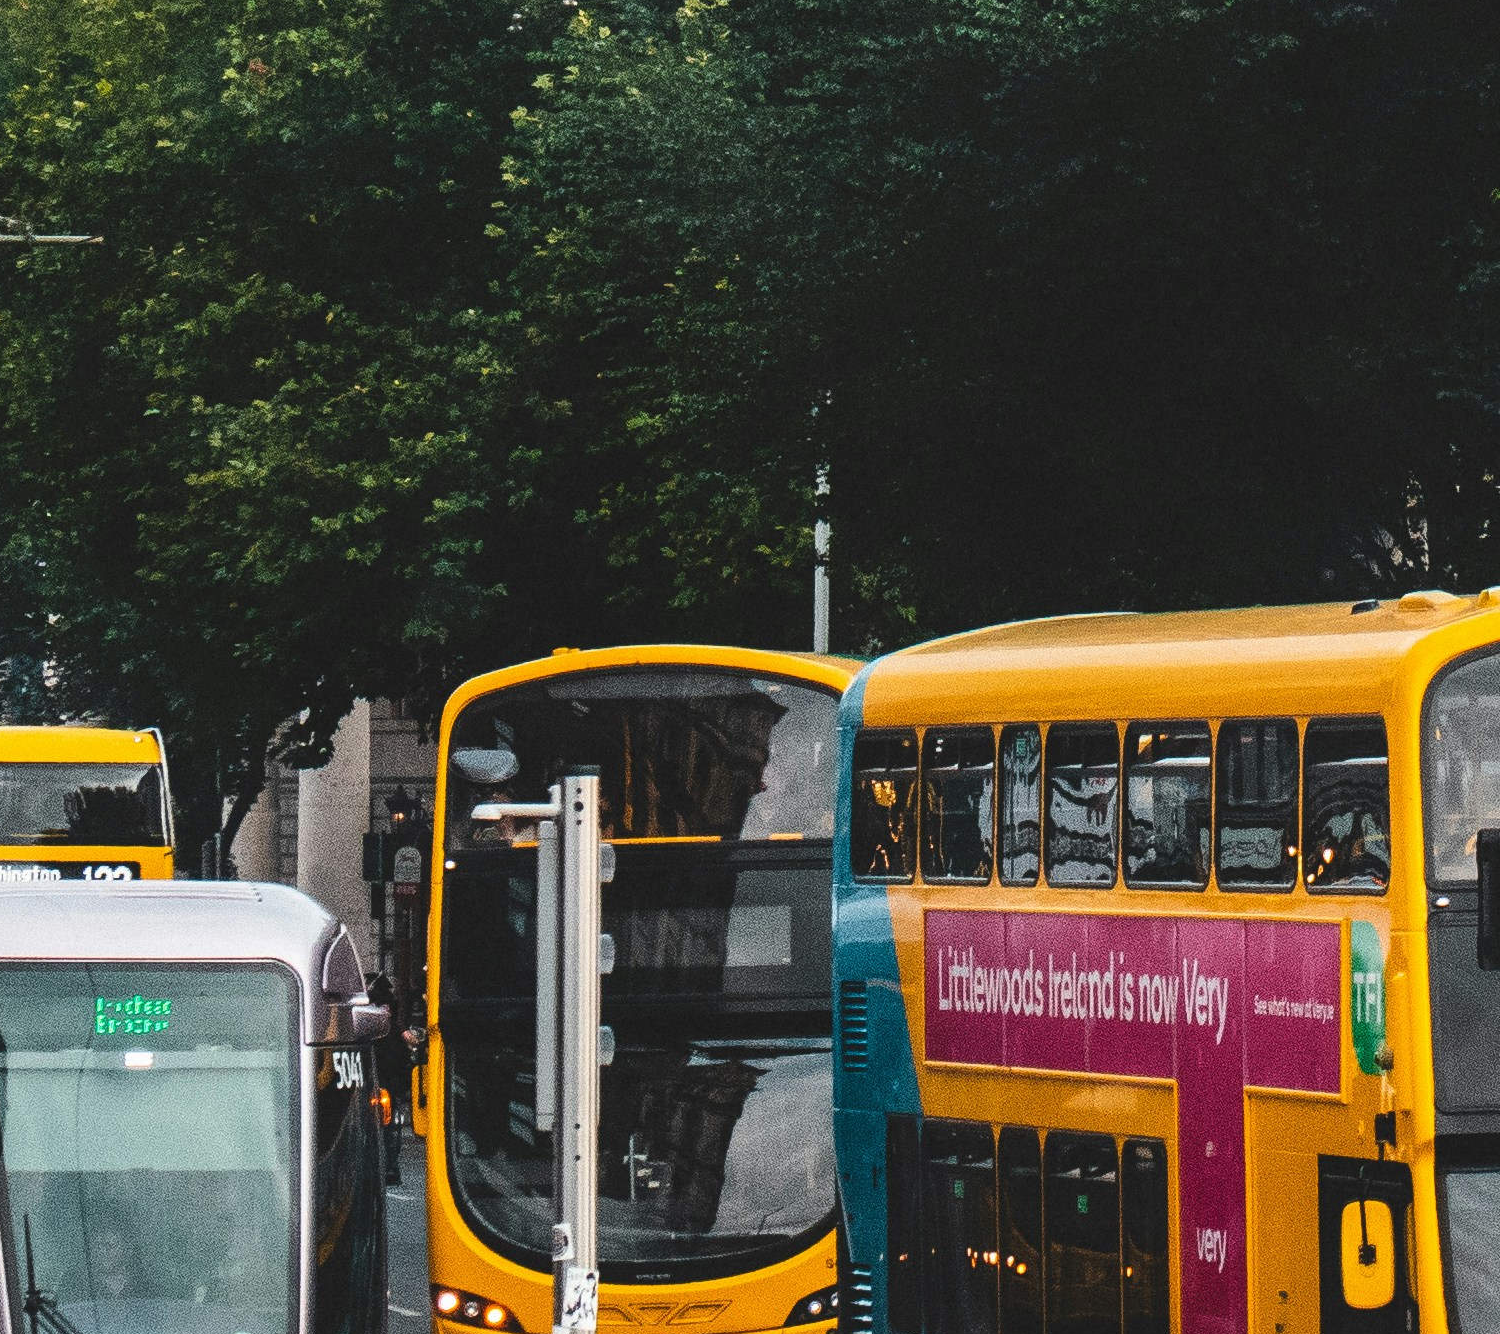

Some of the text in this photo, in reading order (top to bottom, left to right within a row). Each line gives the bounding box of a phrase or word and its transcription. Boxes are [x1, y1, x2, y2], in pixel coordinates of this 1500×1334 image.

[938, 946, 1229, 1045] Littlewoods Ireland is now Very
[1353, 971, 1381, 1024] TFI
[333, 1051, 363, 1090] 5041
[1196, 1227, 1227, 1273] very
